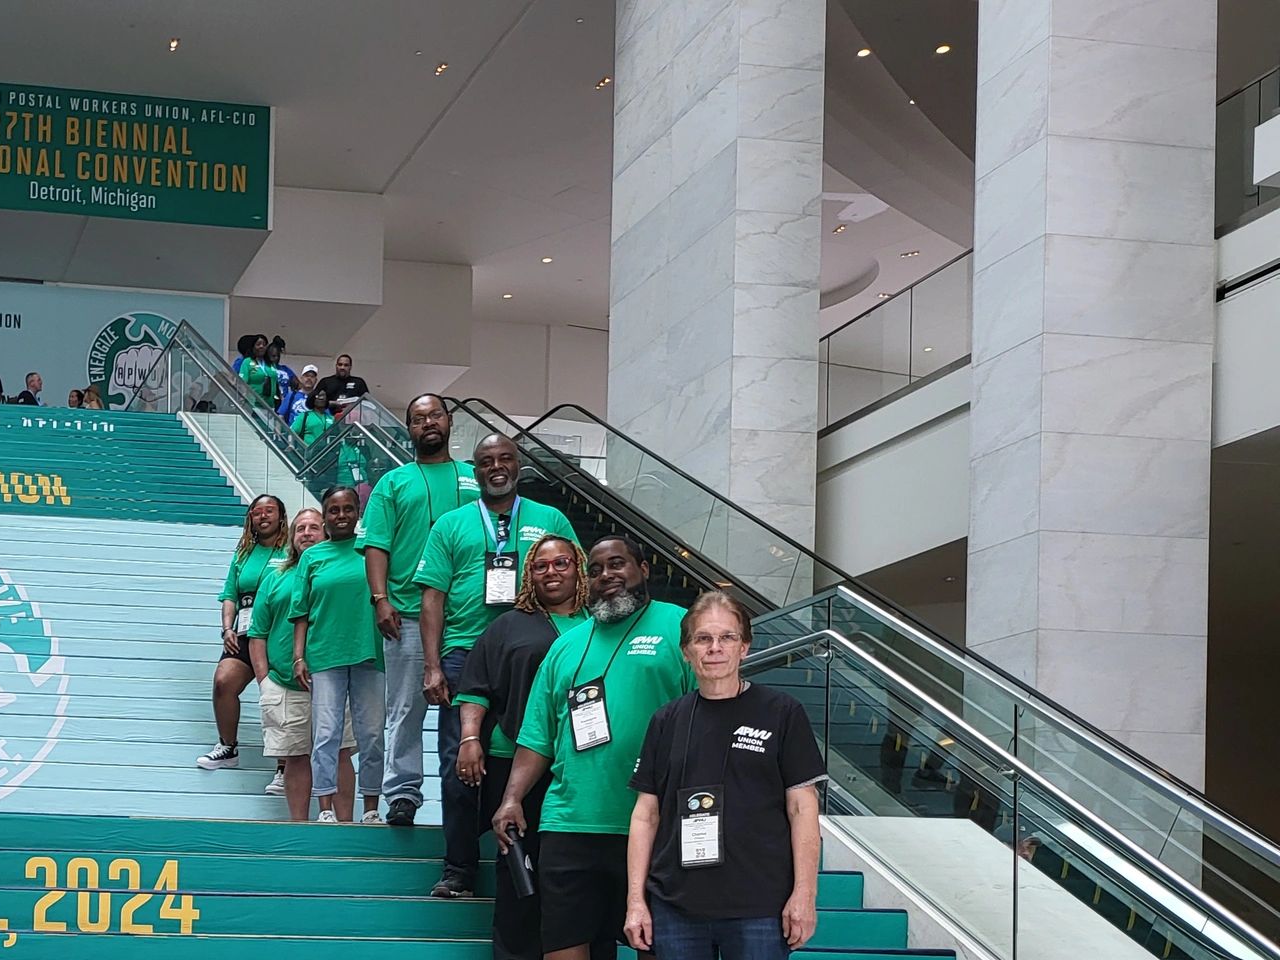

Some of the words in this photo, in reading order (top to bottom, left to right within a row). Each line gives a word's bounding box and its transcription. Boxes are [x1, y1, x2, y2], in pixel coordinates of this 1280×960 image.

[9, 91, 62, 110] POSTAL
[70, 97, 137, 116] WORKERS
[145, 104, 196, 123] UNION,
[200, 110, 256, 127] AFL-CIO
[66, 117, 193, 156] BIENNIAL
[76, 151, 248, 193] CONVENTION
[29, 181, 87, 206] Detroit,
[90, 186, 156, 212] Michigan
[89, 326, 119, 383] ENERGIZE
[731, 742, 766, 754] MEMBER
[733, 725, 773, 740] APWU
[737, 736, 763, 747] UNION
[24, 857, 201, 936] 2024
